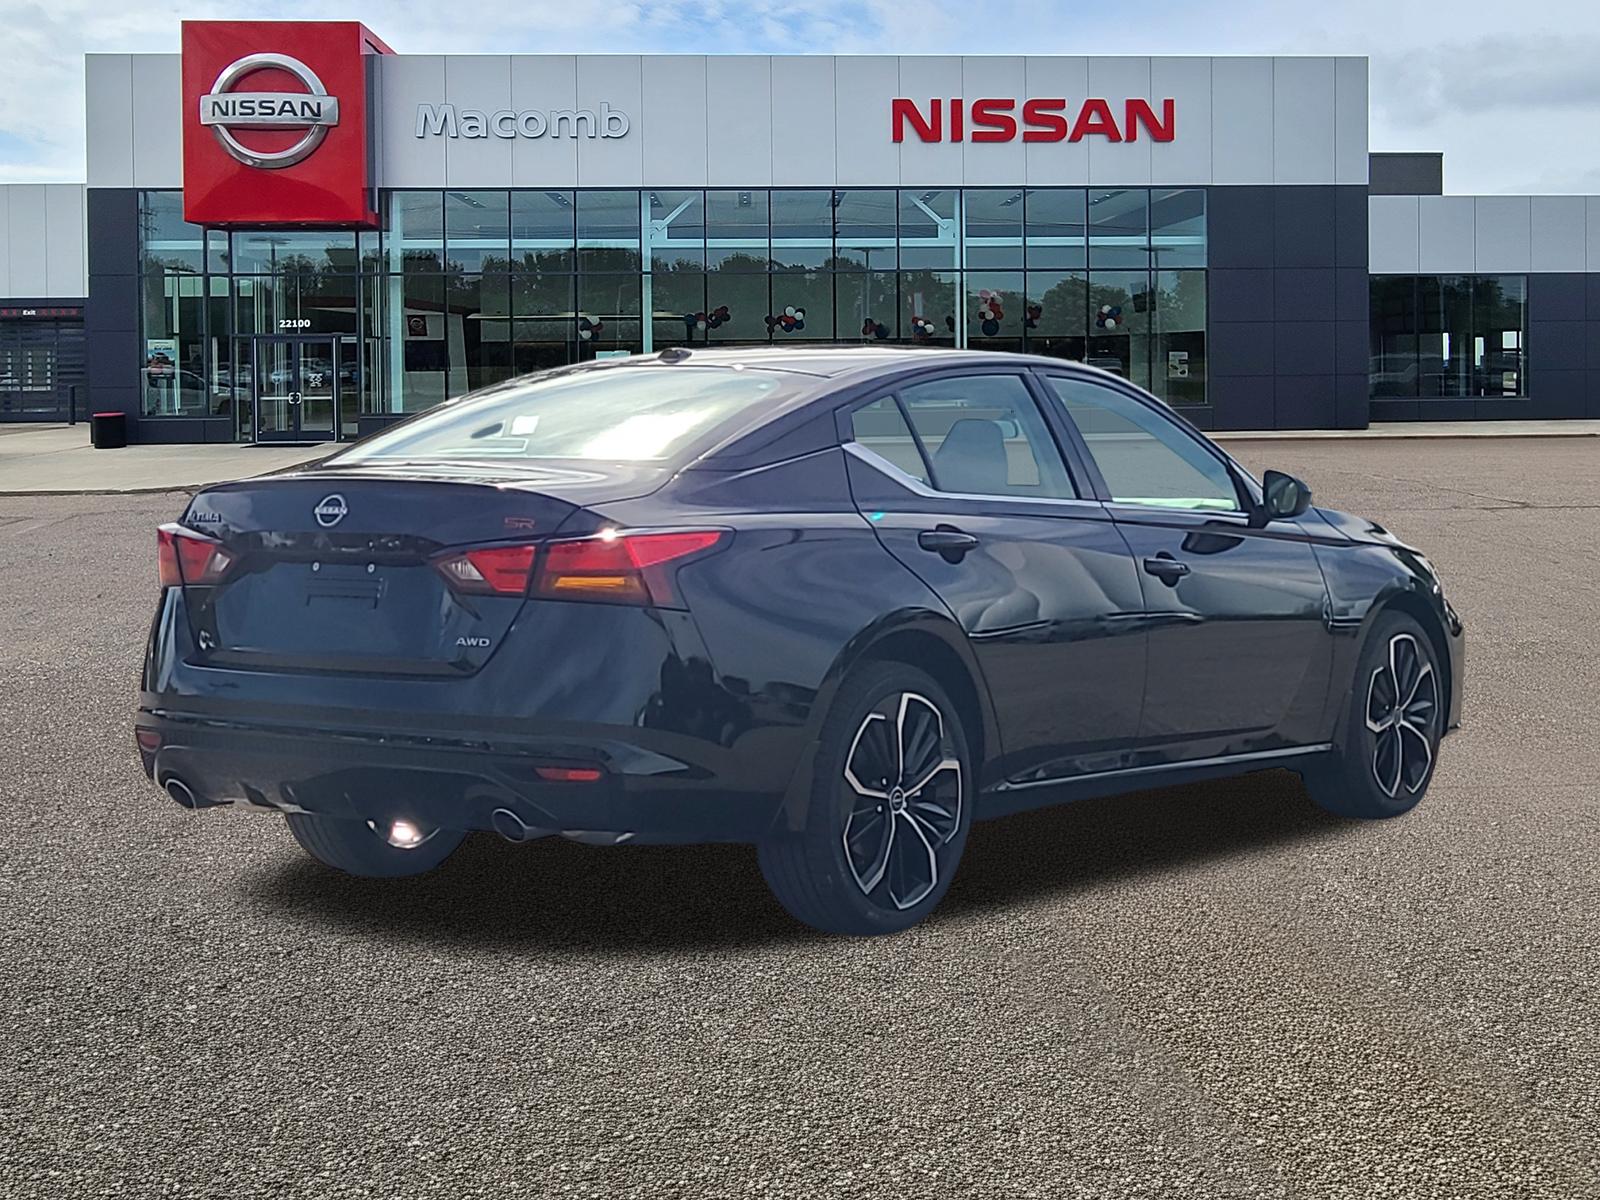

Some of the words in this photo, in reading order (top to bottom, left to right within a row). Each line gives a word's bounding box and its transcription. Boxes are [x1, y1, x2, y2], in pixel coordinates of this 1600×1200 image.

[211, 100, 322, 117] NISSAN
[415, 102, 630, 139] Macomb
[892, 98, 1175, 143] NISSAN
[279, 319, 311, 328] 22100
[504, 517, 535, 528] SR
[456, 637, 490, 646] AWD
